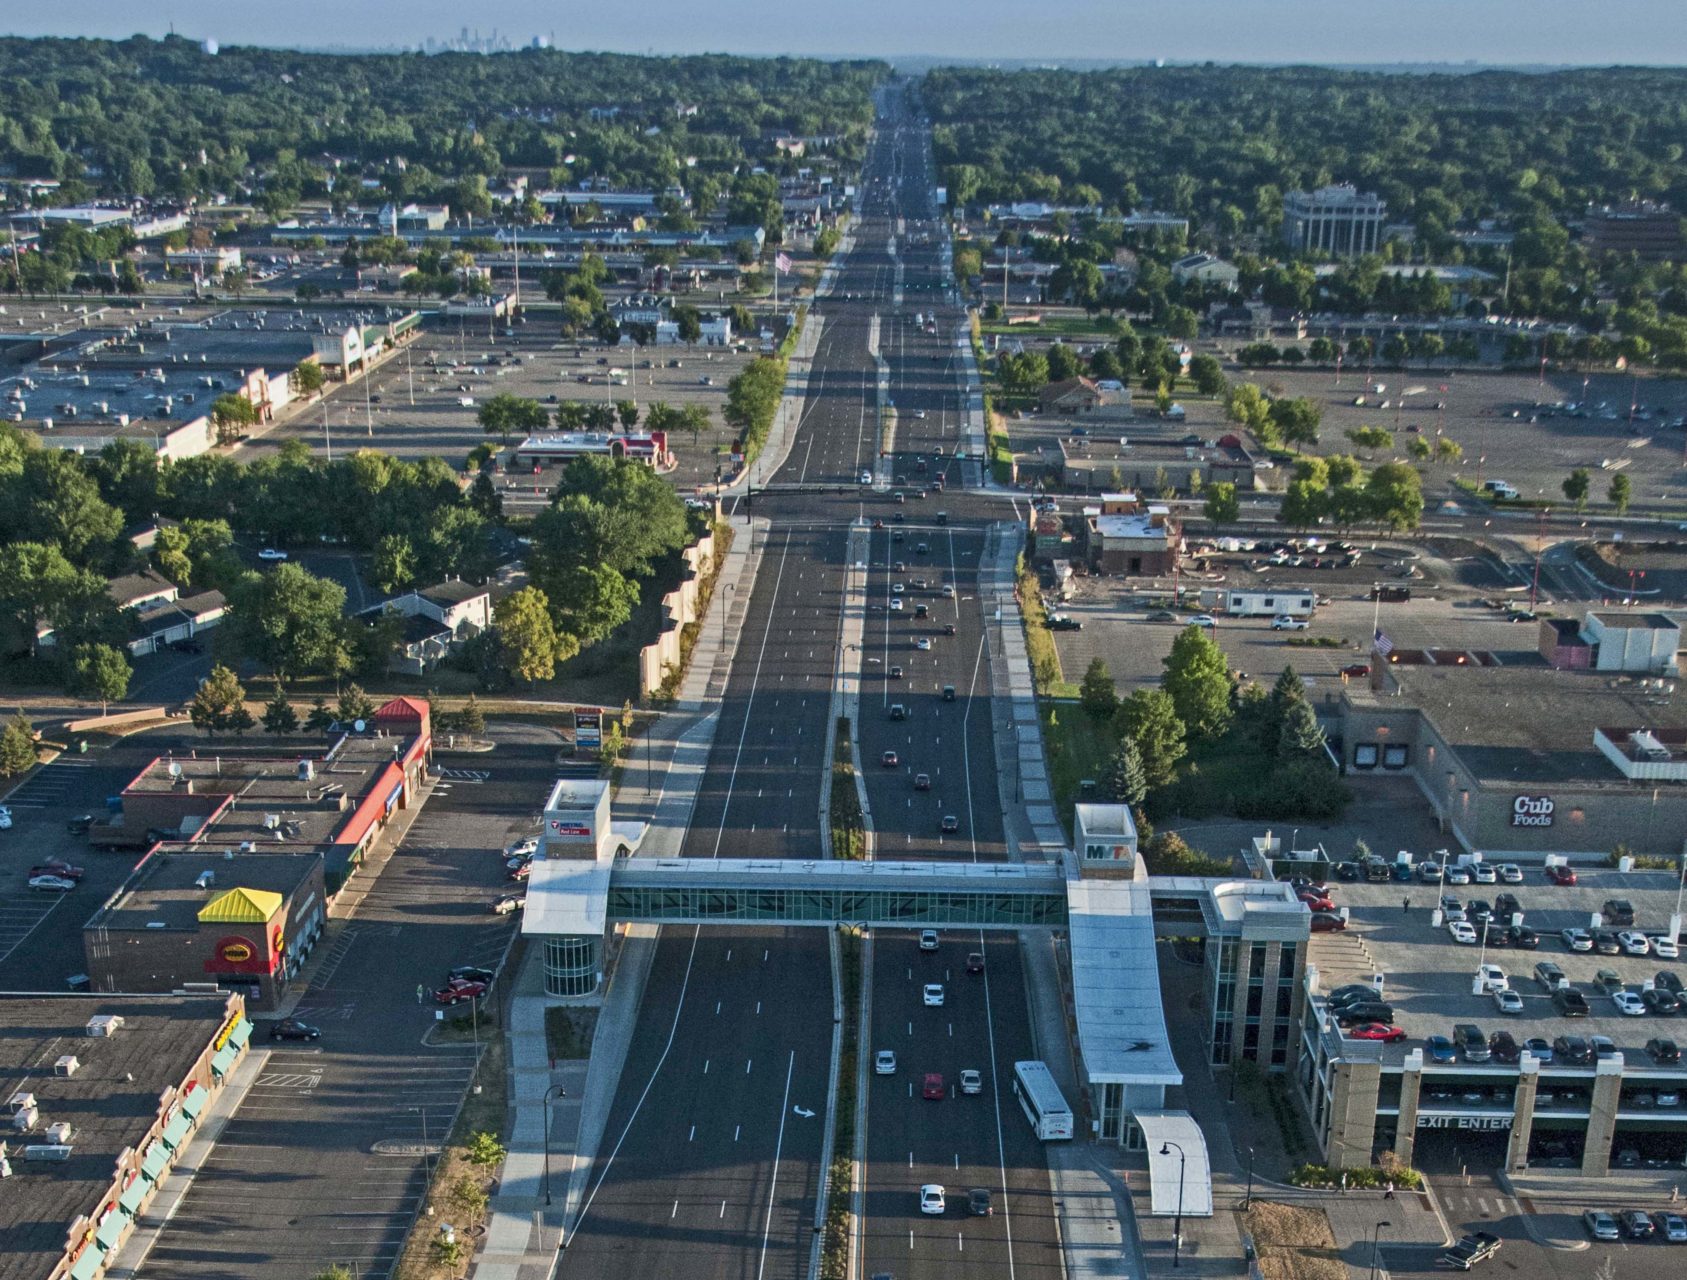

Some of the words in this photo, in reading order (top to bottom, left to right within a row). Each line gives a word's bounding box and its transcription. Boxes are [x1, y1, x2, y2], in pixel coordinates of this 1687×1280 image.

[1514, 796, 1554, 813] Cub
[1512, 814, 1552, 825] Foods
[1416, 1116, 1452, 1128] EXIT
[1458, 1117, 1511, 1129] ENTER
